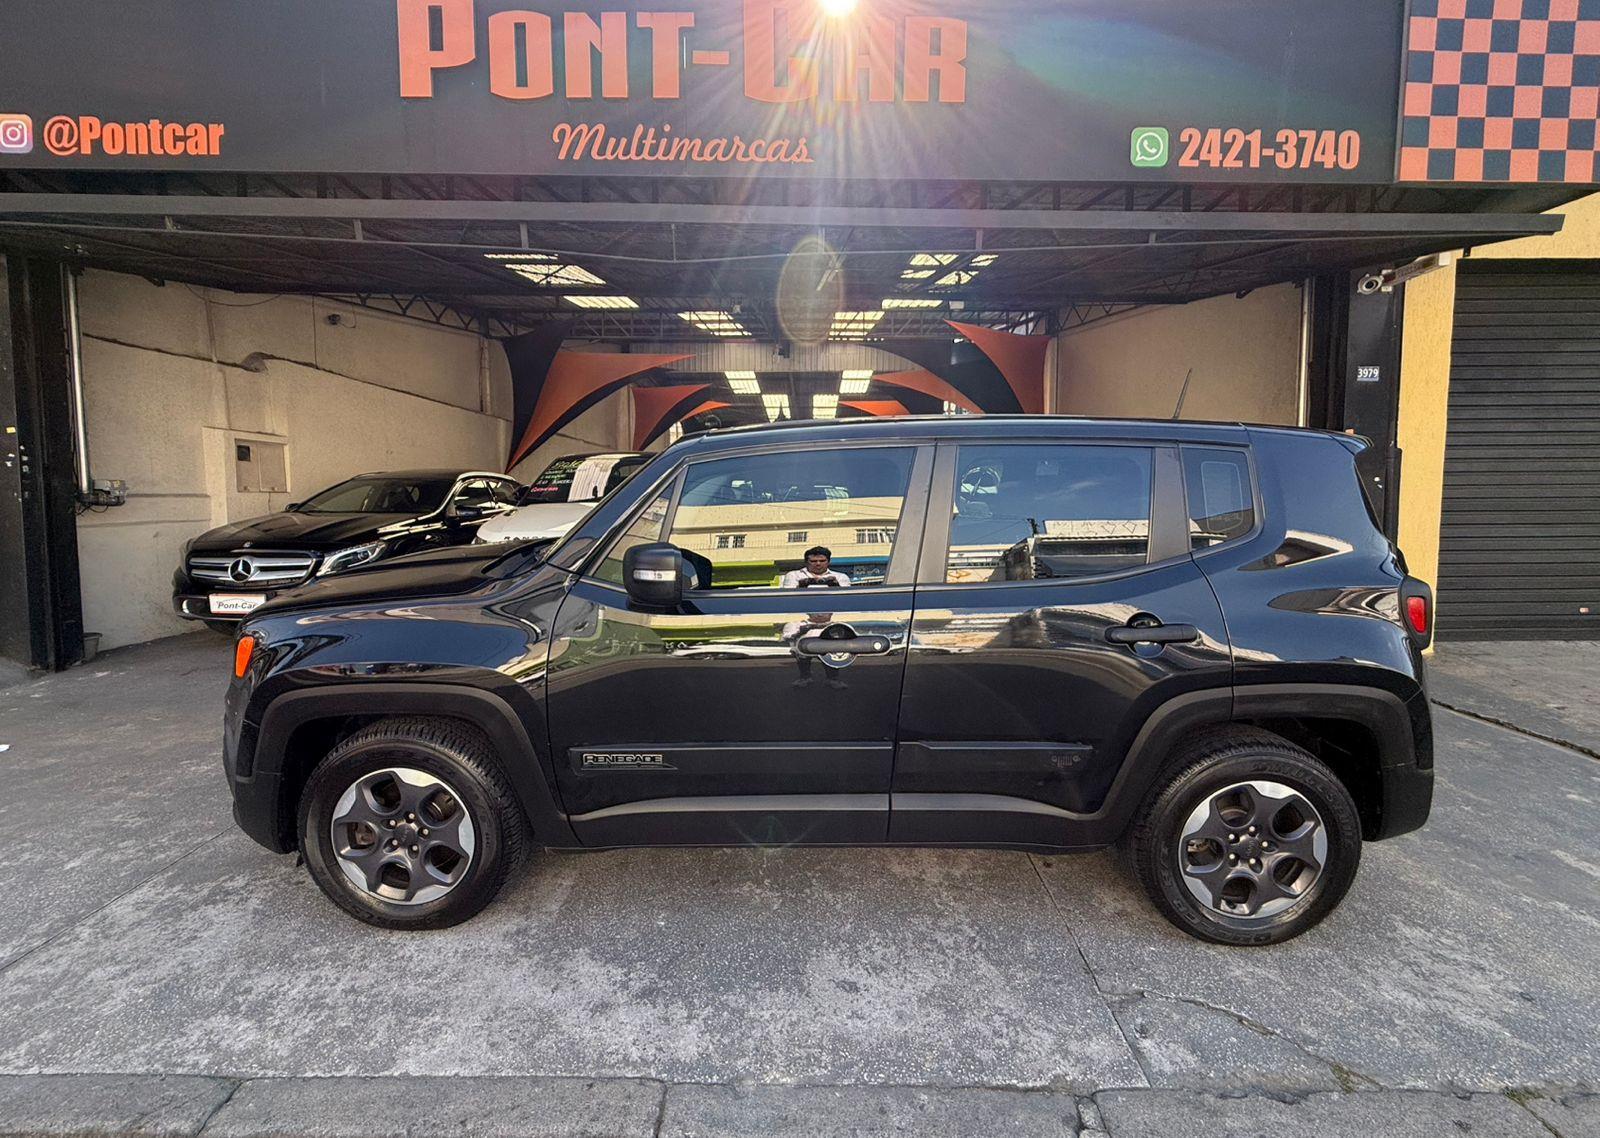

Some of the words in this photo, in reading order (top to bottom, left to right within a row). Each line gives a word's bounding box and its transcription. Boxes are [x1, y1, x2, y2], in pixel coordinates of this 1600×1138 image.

[43, 115, 225, 156] @Pontcar
[552, 123, 815, 163] Multimarcas
[1178, 127, 1361, 170] 2421-3740
[1357, 368, 1379, 378] 3979
[583, 753, 663, 764] RENEGADE
